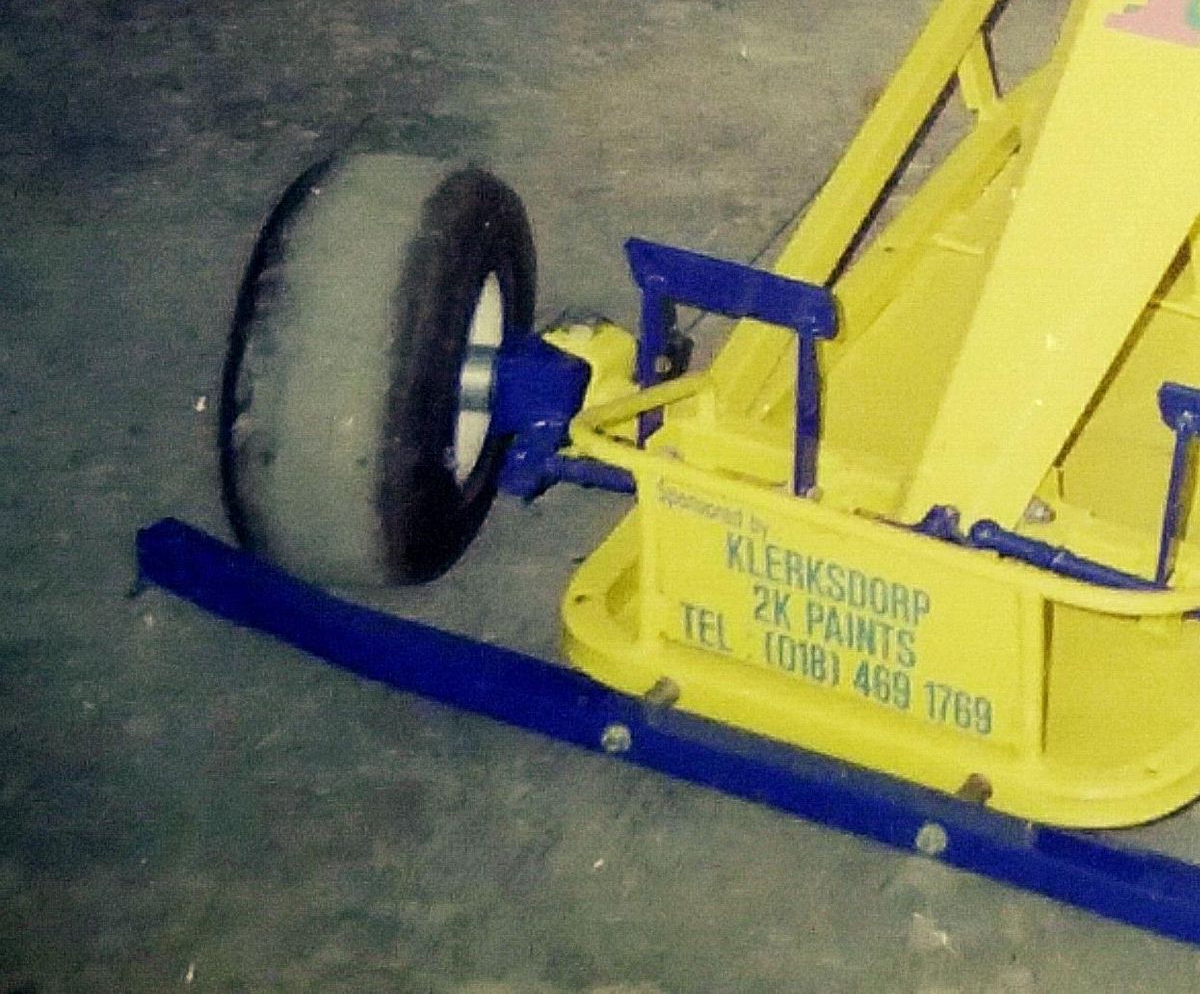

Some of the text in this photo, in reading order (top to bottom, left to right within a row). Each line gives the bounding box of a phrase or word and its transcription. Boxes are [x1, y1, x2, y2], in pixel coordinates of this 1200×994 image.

[726, 531, 930, 627] KLERKSDORP
[753, 584, 917, 668] 2K PAINTS
[680, 601, 731, 651] TEL
[853, 660, 911, 711] 469
[923, 679, 992, 735] 1769
